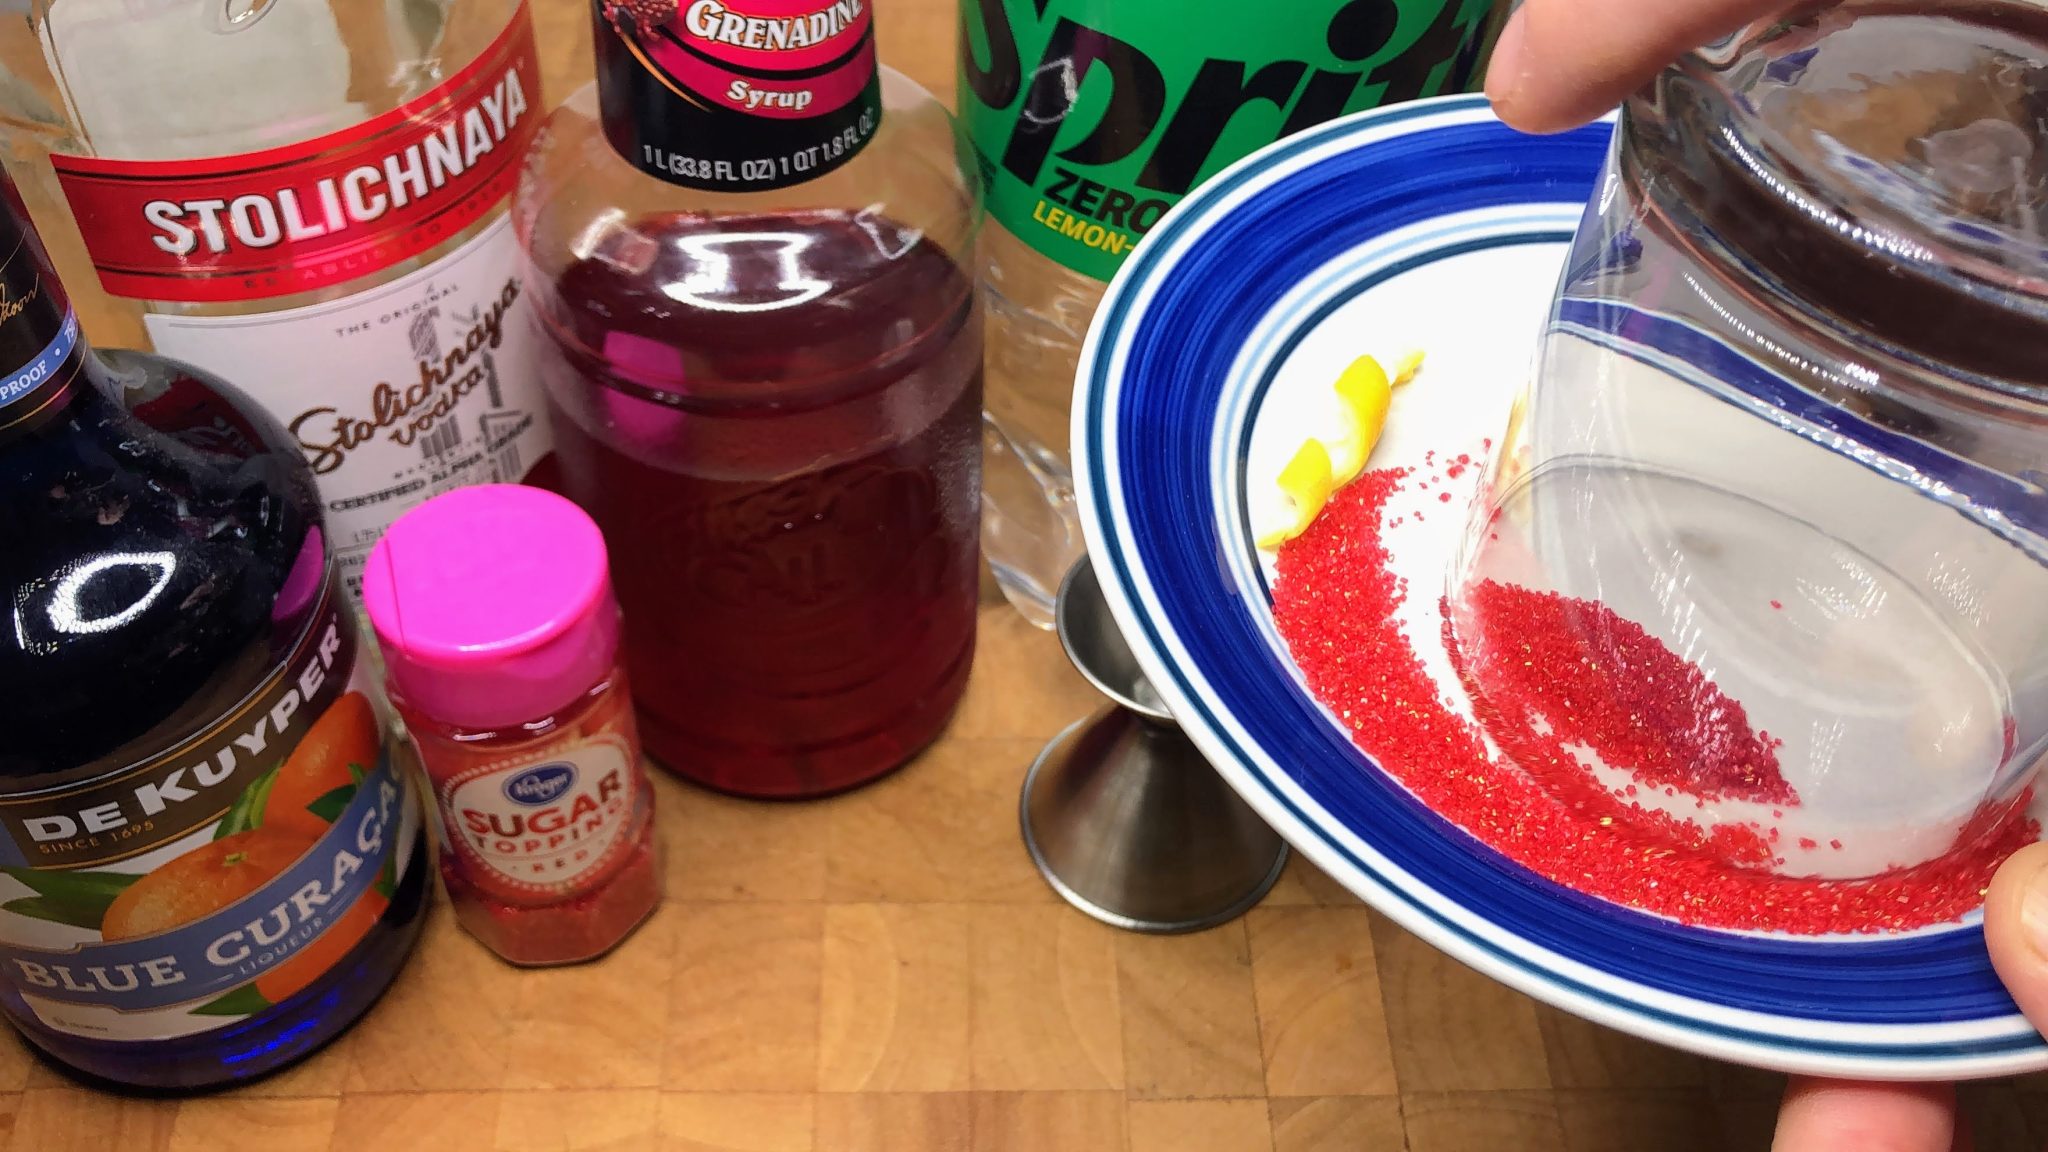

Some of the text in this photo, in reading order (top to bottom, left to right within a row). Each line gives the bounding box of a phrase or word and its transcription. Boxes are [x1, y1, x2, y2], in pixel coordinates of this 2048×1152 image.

[686, 0, 864, 50] GRENADINE
[727, 80, 813, 110] Syrup
[144, 69, 527, 256] STOLICHNAYA
[643, 144, 654, 164] 1
[655, 149, 668, 170] L
[669, 152, 711, 181] (33.8
[714, 161, 739, 182] FL
[741, 157, 776, 182] OZ)
[779, 156, 790, 176] 1
[793, 147, 820, 173] QT
[822, 135, 844, 161] 1.8
[843, 124, 860, 150] FL
[1032, 200, 1135, 255] LEMON-
[1043, 166, 1171, 235] ZERO
[335, 321, 370, 337] THE
[0, 359, 47, 400] PROOF
[288, 277, 522, 476] Stolichnaya
[388, 364, 485, 448] vodka
[22, 623, 341, 842] DE KUYPER
[463, 768, 622, 837] SUGAR
[38, 819, 155, 855] SINCE 1695
[532, 850, 588, 872] RED
[12, 765, 398, 993] BLUE CURAÇA
[239, 917, 323, 975] LIQUEUR
